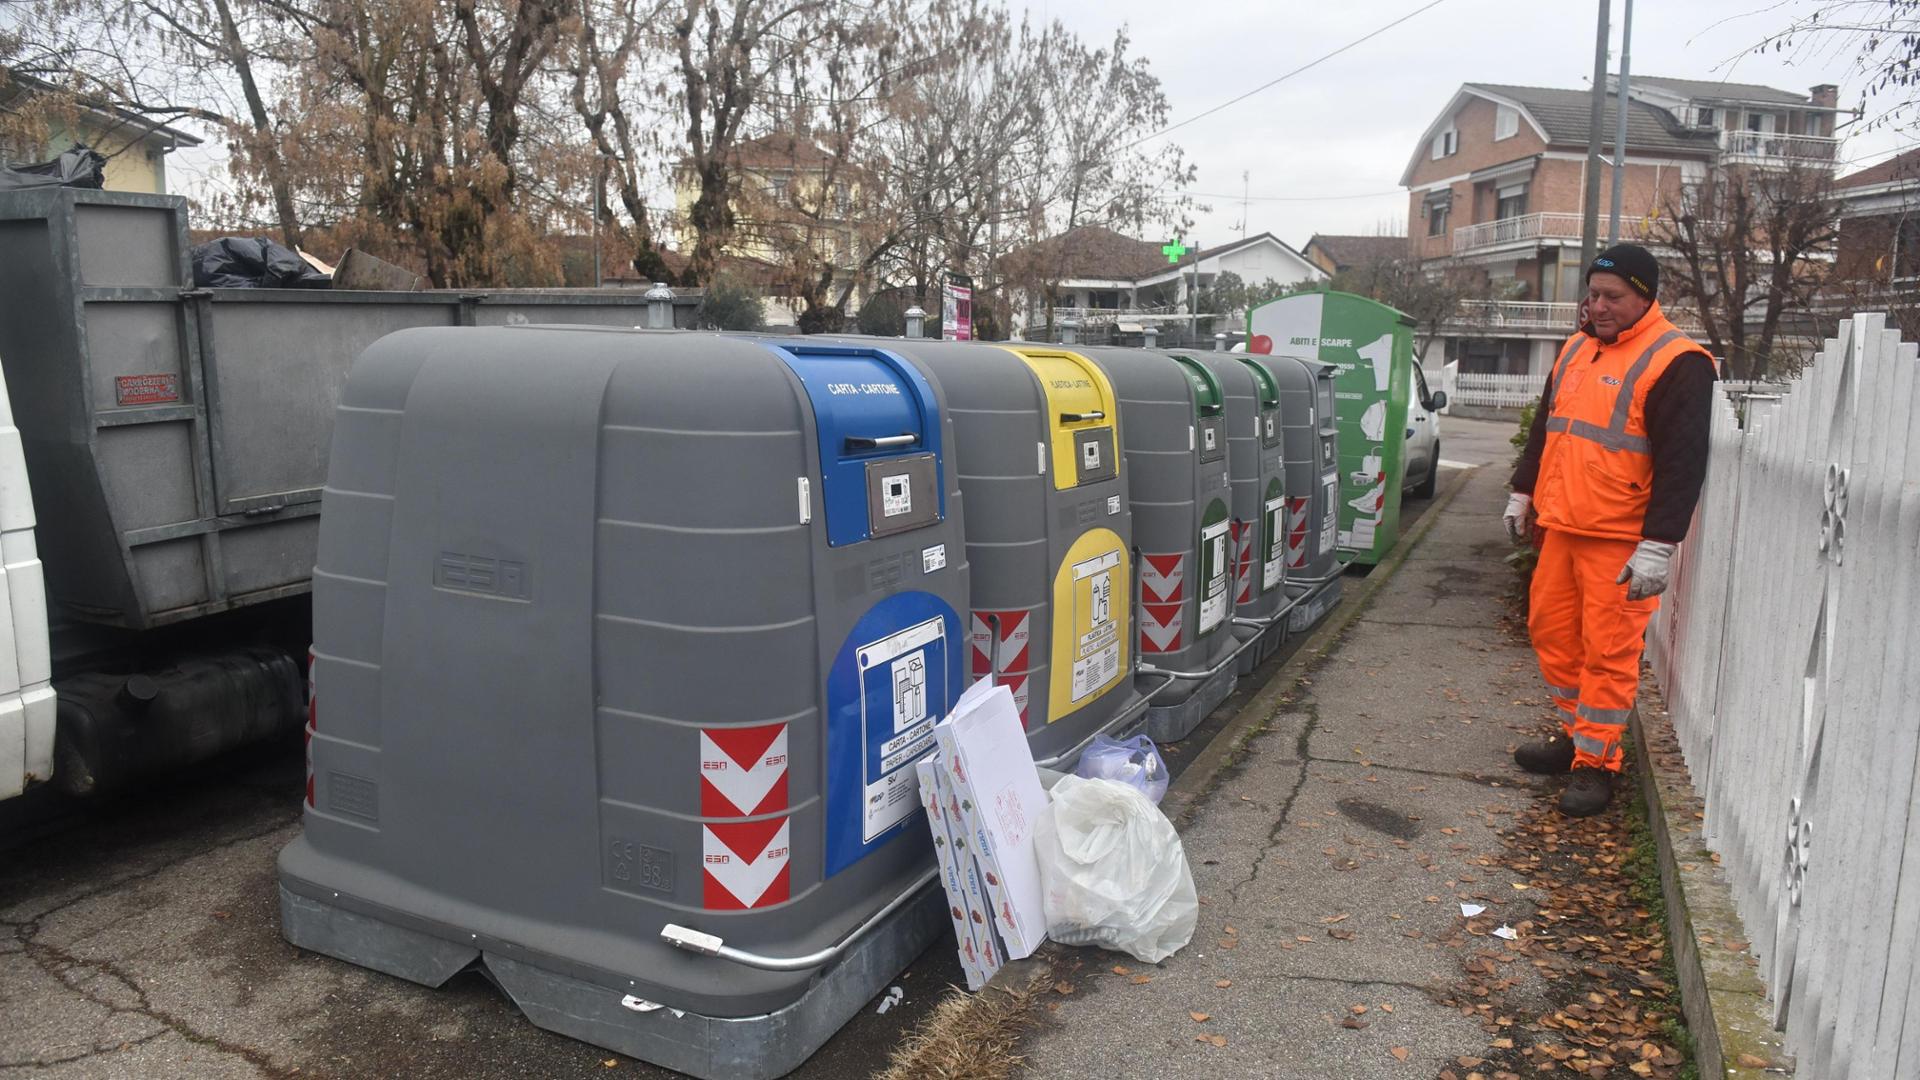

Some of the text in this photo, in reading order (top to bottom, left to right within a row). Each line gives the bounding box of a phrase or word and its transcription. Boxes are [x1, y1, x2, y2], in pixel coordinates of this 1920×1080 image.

[1290, 337, 1352, 348] ABITI E SCARPE
[827, 383, 859, 395] CARTA
[861, 383, 900, 395] CARTONE
[888, 737, 907, 752] CARTA
[910, 720, 932, 741] CARTONE
[885, 753, 903, 769] PAPER
[905, 734, 934, 760] CARDBOARD
